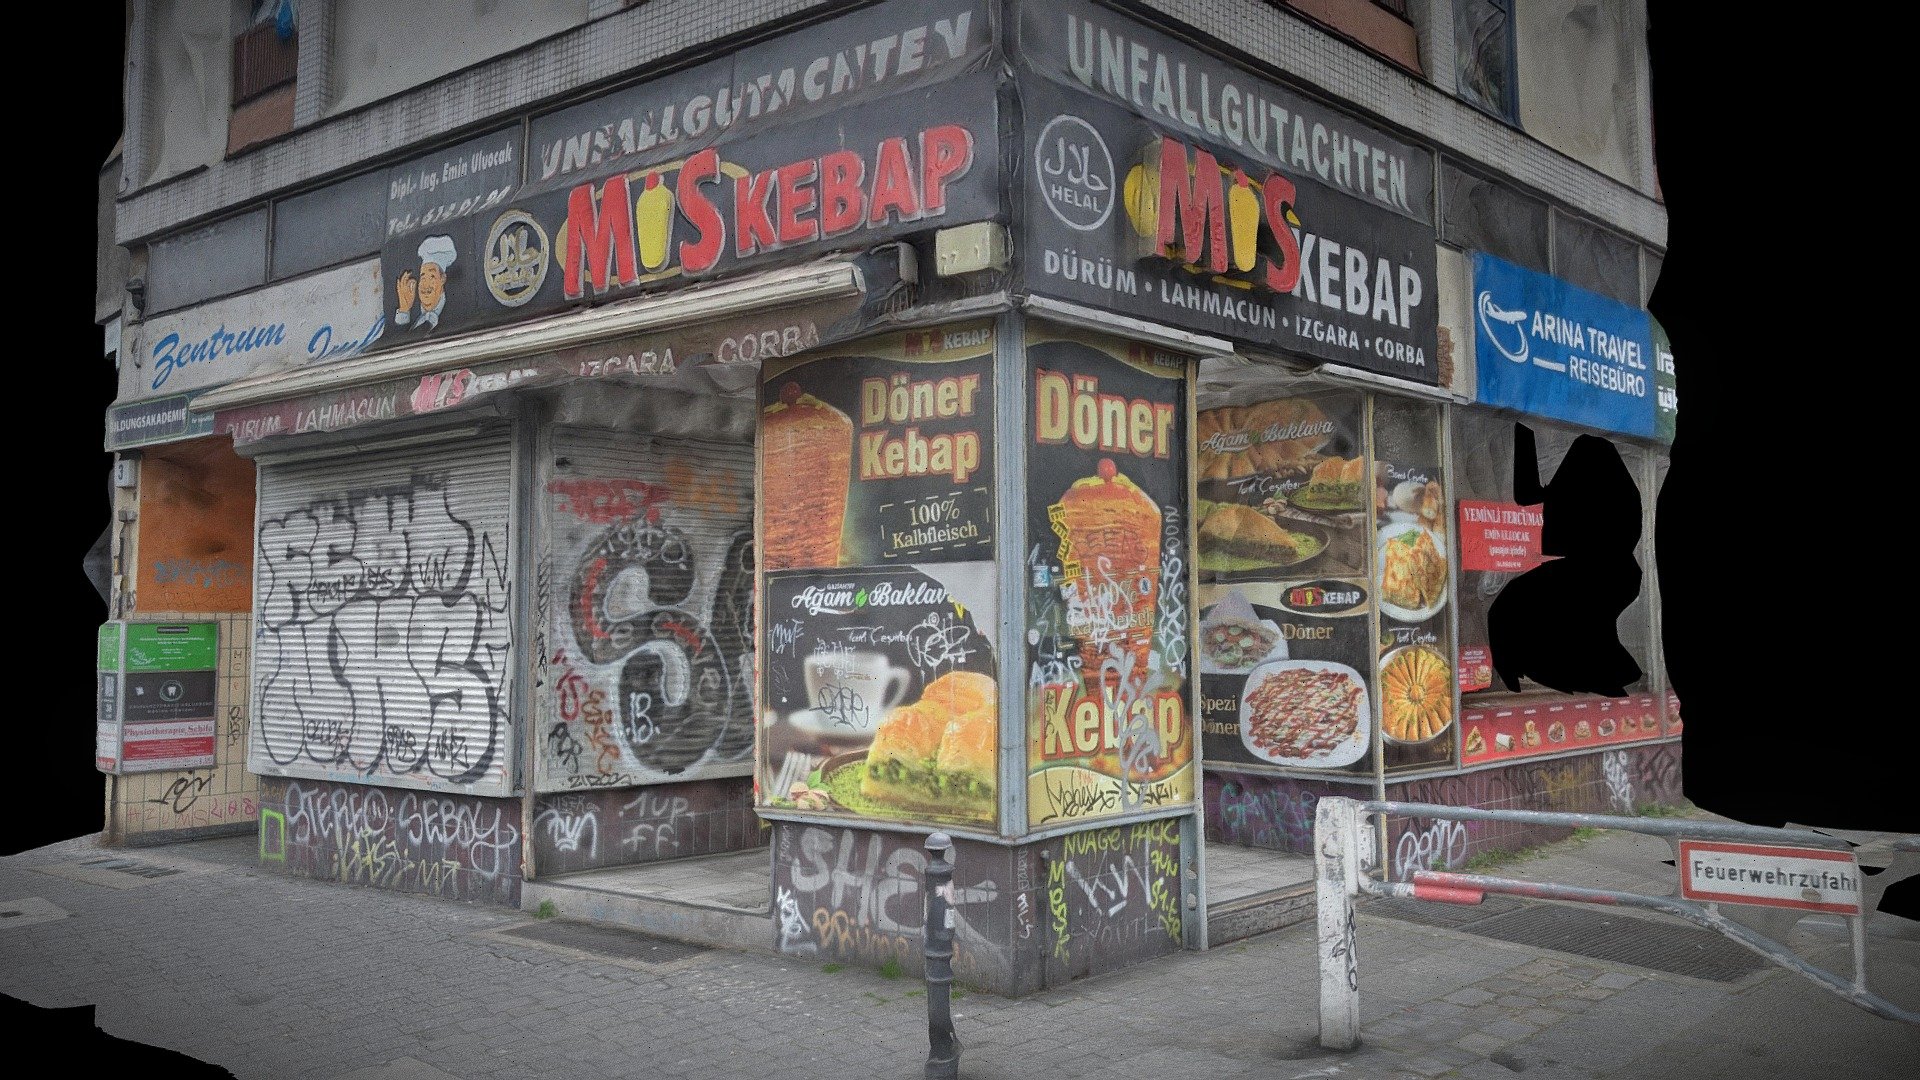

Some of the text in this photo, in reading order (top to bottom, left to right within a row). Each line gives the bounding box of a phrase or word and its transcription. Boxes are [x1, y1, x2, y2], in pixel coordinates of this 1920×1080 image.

[1067, 13, 1411, 213] UNFALLGUTACHTEN
[419, 171, 440, 193] Ing.
[441, 156, 469, 184] Emin
[735, 124, 974, 258] KEBAP
[1050, 186, 1104, 214] HELAL
[1292, 228, 1423, 330] KEBAP
[1043, 247, 1426, 368] DÜRÜM LAHMACUN IZGARA CORBA
[151, 322, 286, 390] Zentrum
[943, 328, 991, 351] KEBAP
[1531, 310, 1585, 352] ARINA
[1587, 326, 1647, 371] TRAVEL
[1152, 351, 1184, 369] KEBAP
[1569, 354, 1646, 398] REISEBÜRO
[861, 373, 981, 428] Döner
[1035, 368, 1175, 460] Döner
[1261, 419, 1335, 444] Baklava
[117, 464, 124, 480] 3
[859, 427, 981, 484] Kebap
[909, 499, 961, 527] 100%
[892, 520, 979, 550] Kalbfleisch
[791, 586, 854, 616] Ağam
[1323, 591, 1360, 605] KEBAP
[1282, 623, 1334, 641] Döner
[1040, 682, 1186, 764] Kebap
